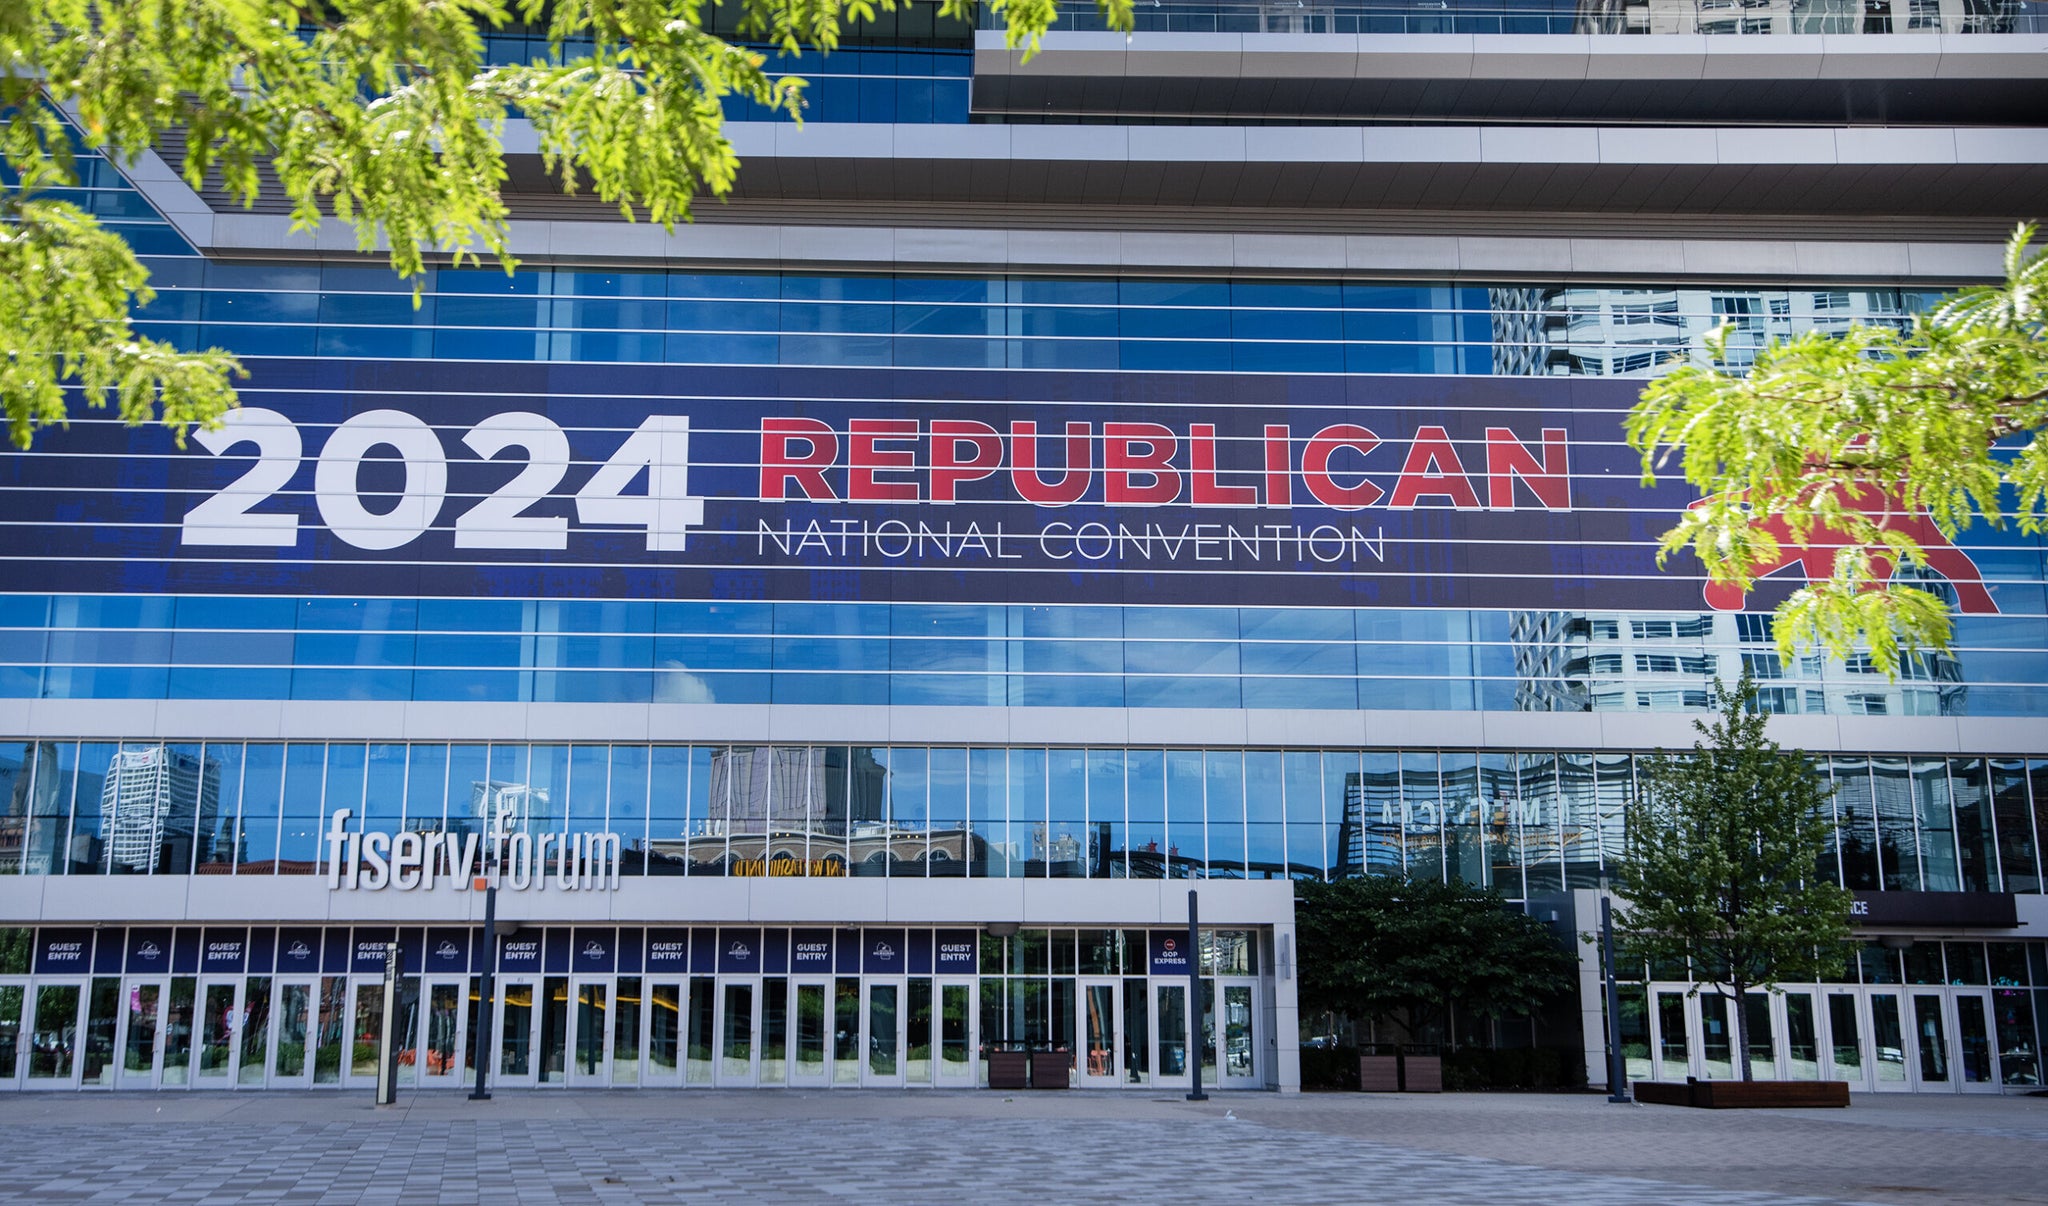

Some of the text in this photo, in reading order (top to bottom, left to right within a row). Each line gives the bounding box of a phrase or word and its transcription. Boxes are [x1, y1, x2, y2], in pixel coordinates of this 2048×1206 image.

[757, 416, 1573, 513] REPUBLICAN
[181, 407, 704, 551] 2024
[757, 517, 1386, 564] NATIONAL CONVENTION
[489, 810, 621, 892] forum
[48, 943, 82, 951] GUEST
[209, 942, 242, 951] GUEST
[505, 942, 538, 951] GUEST
[651, 942, 683, 951] GUEST
[796, 943, 828, 952] GUEST
[940, 944, 972, 953] GUEST
[47, 952, 81, 961] ENTRY
[208, 951, 241, 960] ENTRY
[504, 951, 538, 960] ENTRY
[651, 951, 683, 960] ENTRY
[796, 952, 828, 961] ENTRY
[940, 953, 972, 962] ENTRY
